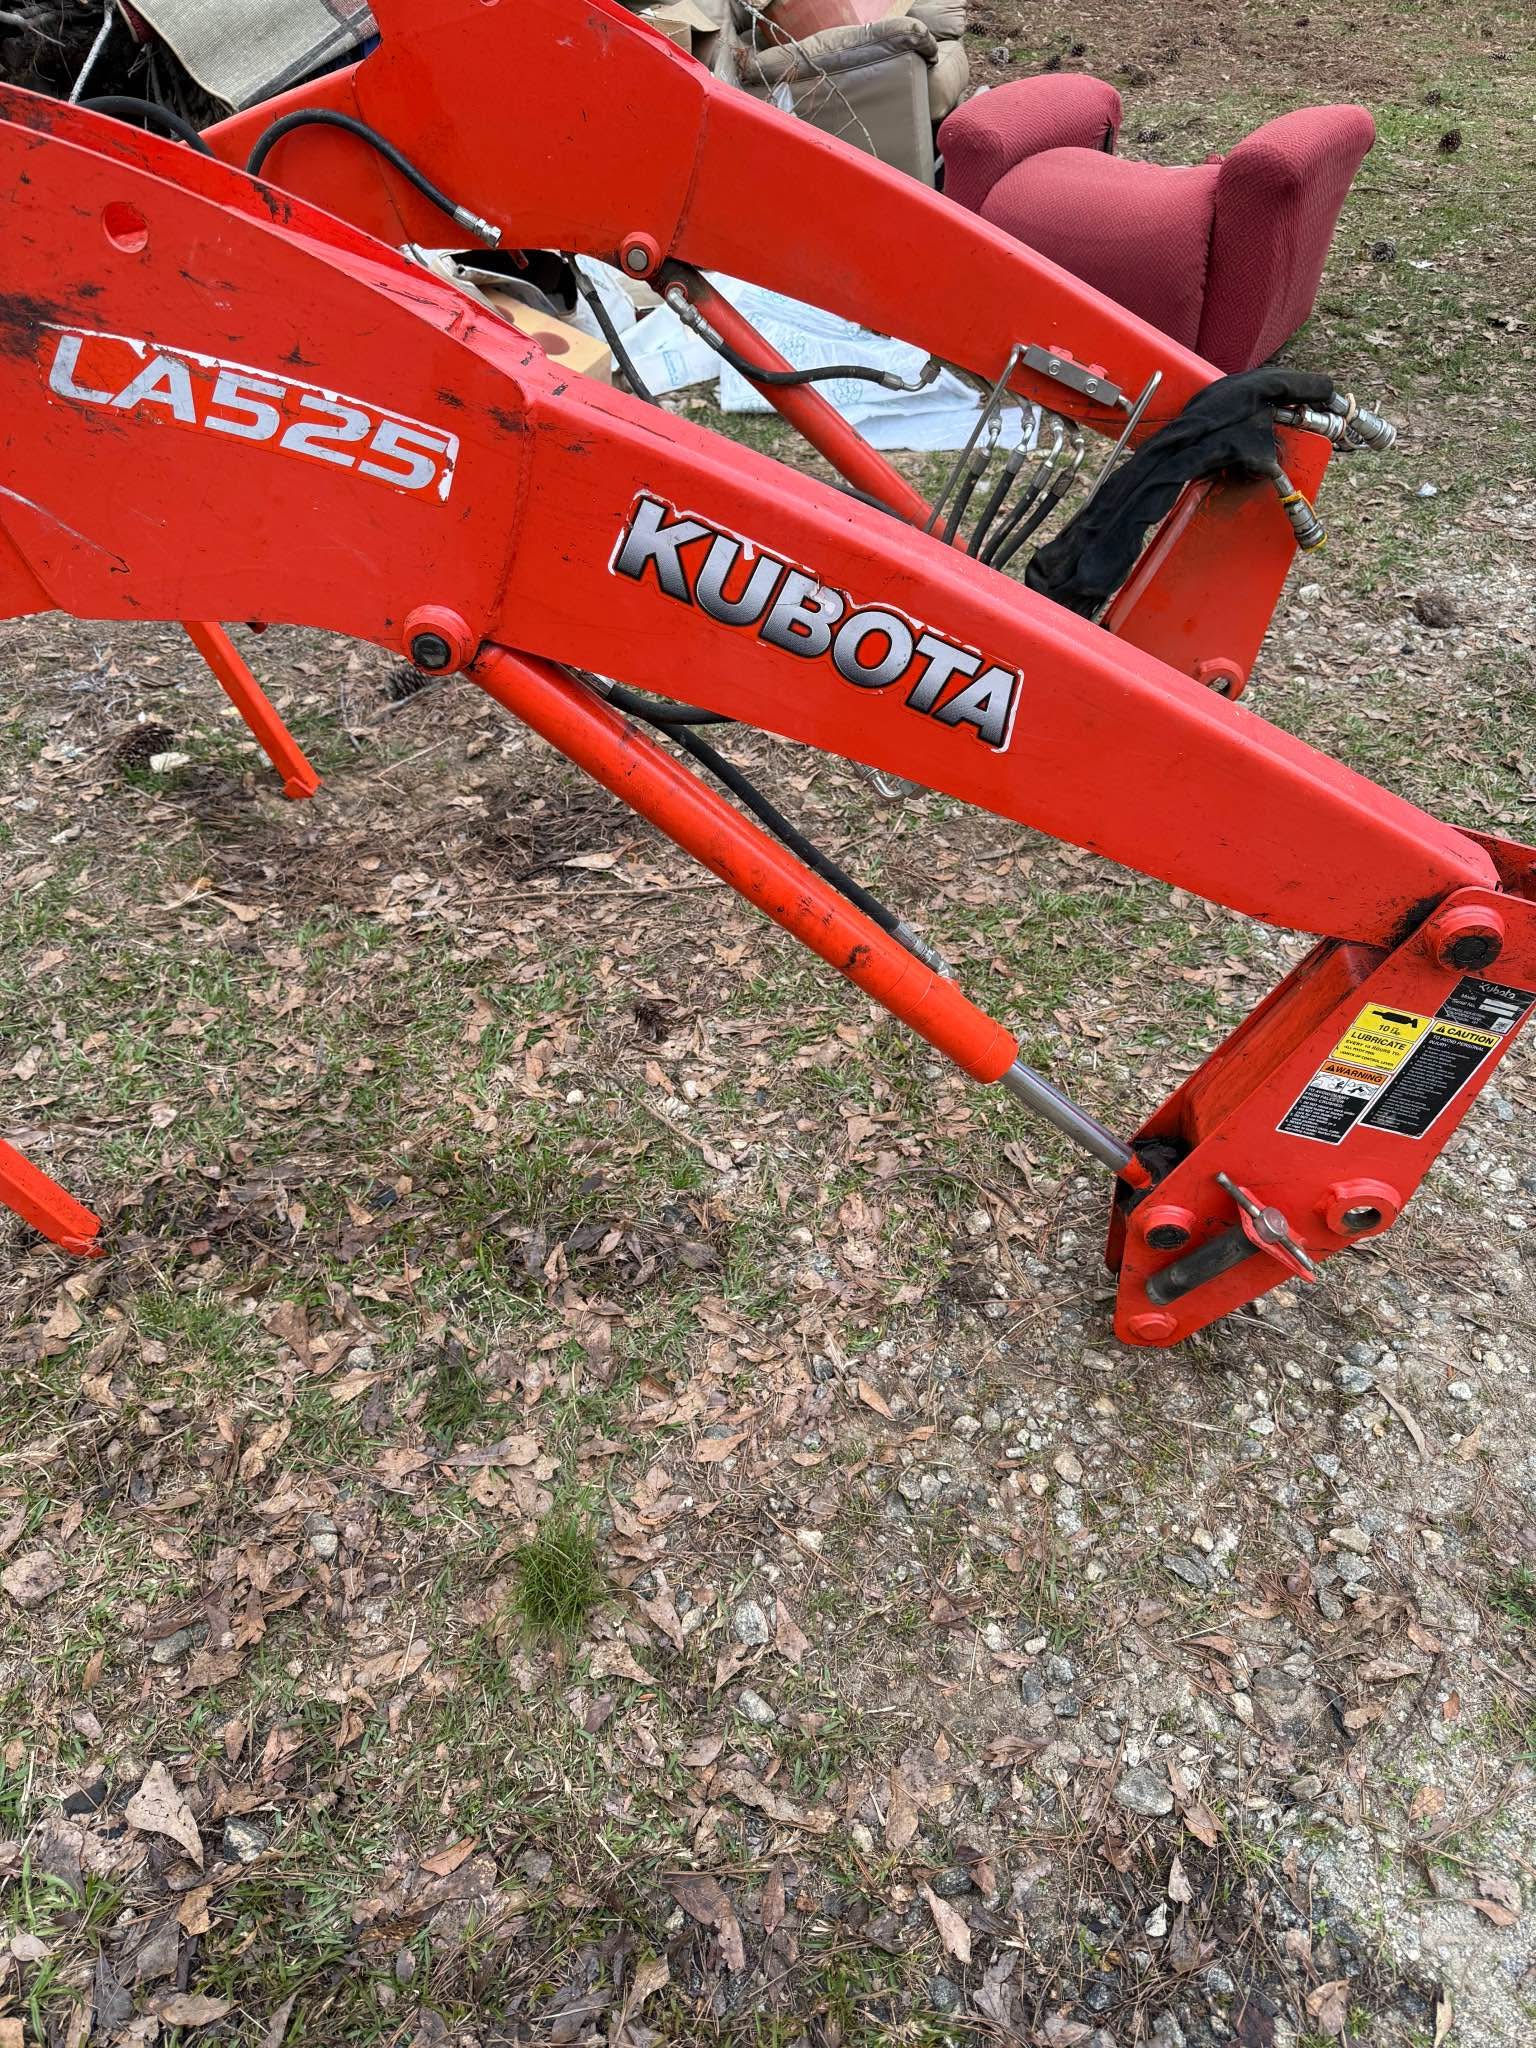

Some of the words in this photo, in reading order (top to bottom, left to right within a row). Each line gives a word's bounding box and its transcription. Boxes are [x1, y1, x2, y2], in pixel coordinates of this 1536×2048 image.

[49, 335, 447, 490] LA525
[614, 496, 1018, 747] KUBOTA
[1479, 982, 1516, 999] Kubota
[1378, 1024, 1390, 1032] 10
[1447, 1028, 1494, 1045] CAUTION
[1351, 1031, 1407, 1051] LUBRICATE
[1440, 1037, 1457, 1045] AVOID
[1335, 1065, 1383, 1083] WARNING
